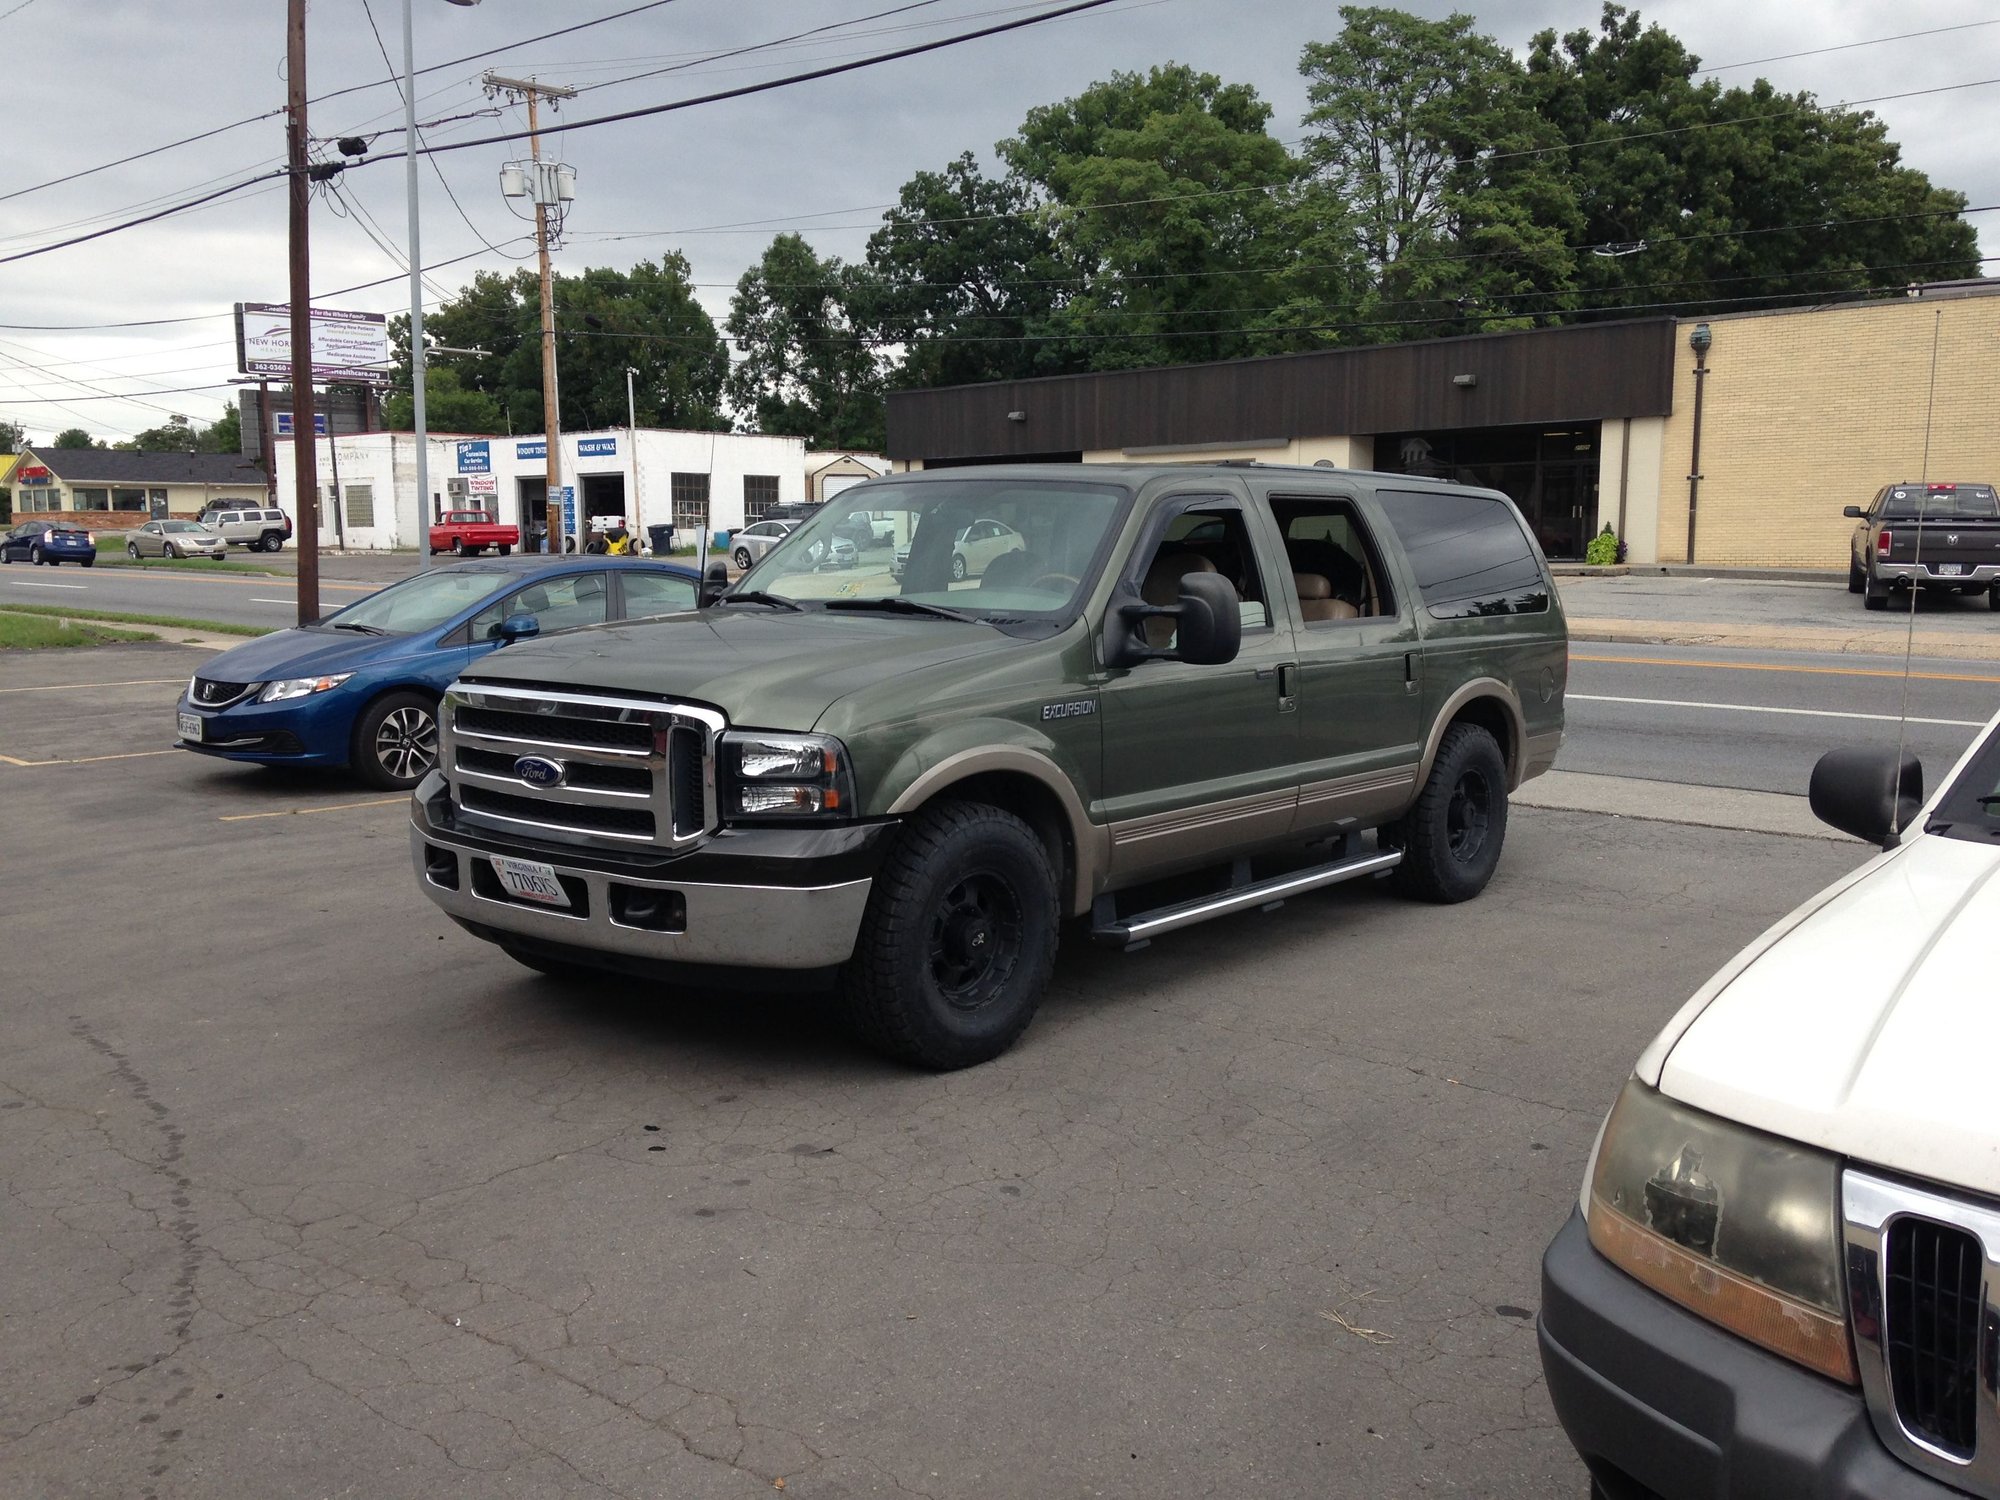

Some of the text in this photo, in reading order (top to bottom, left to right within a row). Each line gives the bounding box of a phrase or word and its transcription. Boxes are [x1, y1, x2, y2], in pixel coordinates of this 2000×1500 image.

[248, 337, 269, 345] NEW
[254, 363, 287, 371] 362-0360
[517, 446, 535, 455] WINDOW
[578, 442, 616, 452] WASH & WAX
[336, 451, 369, 461] OMPANY
[1043, 699, 1096, 720] EXCURSION
[521, 760, 547, 780] Ford
[506, 861, 539, 874] VIRGINIA
